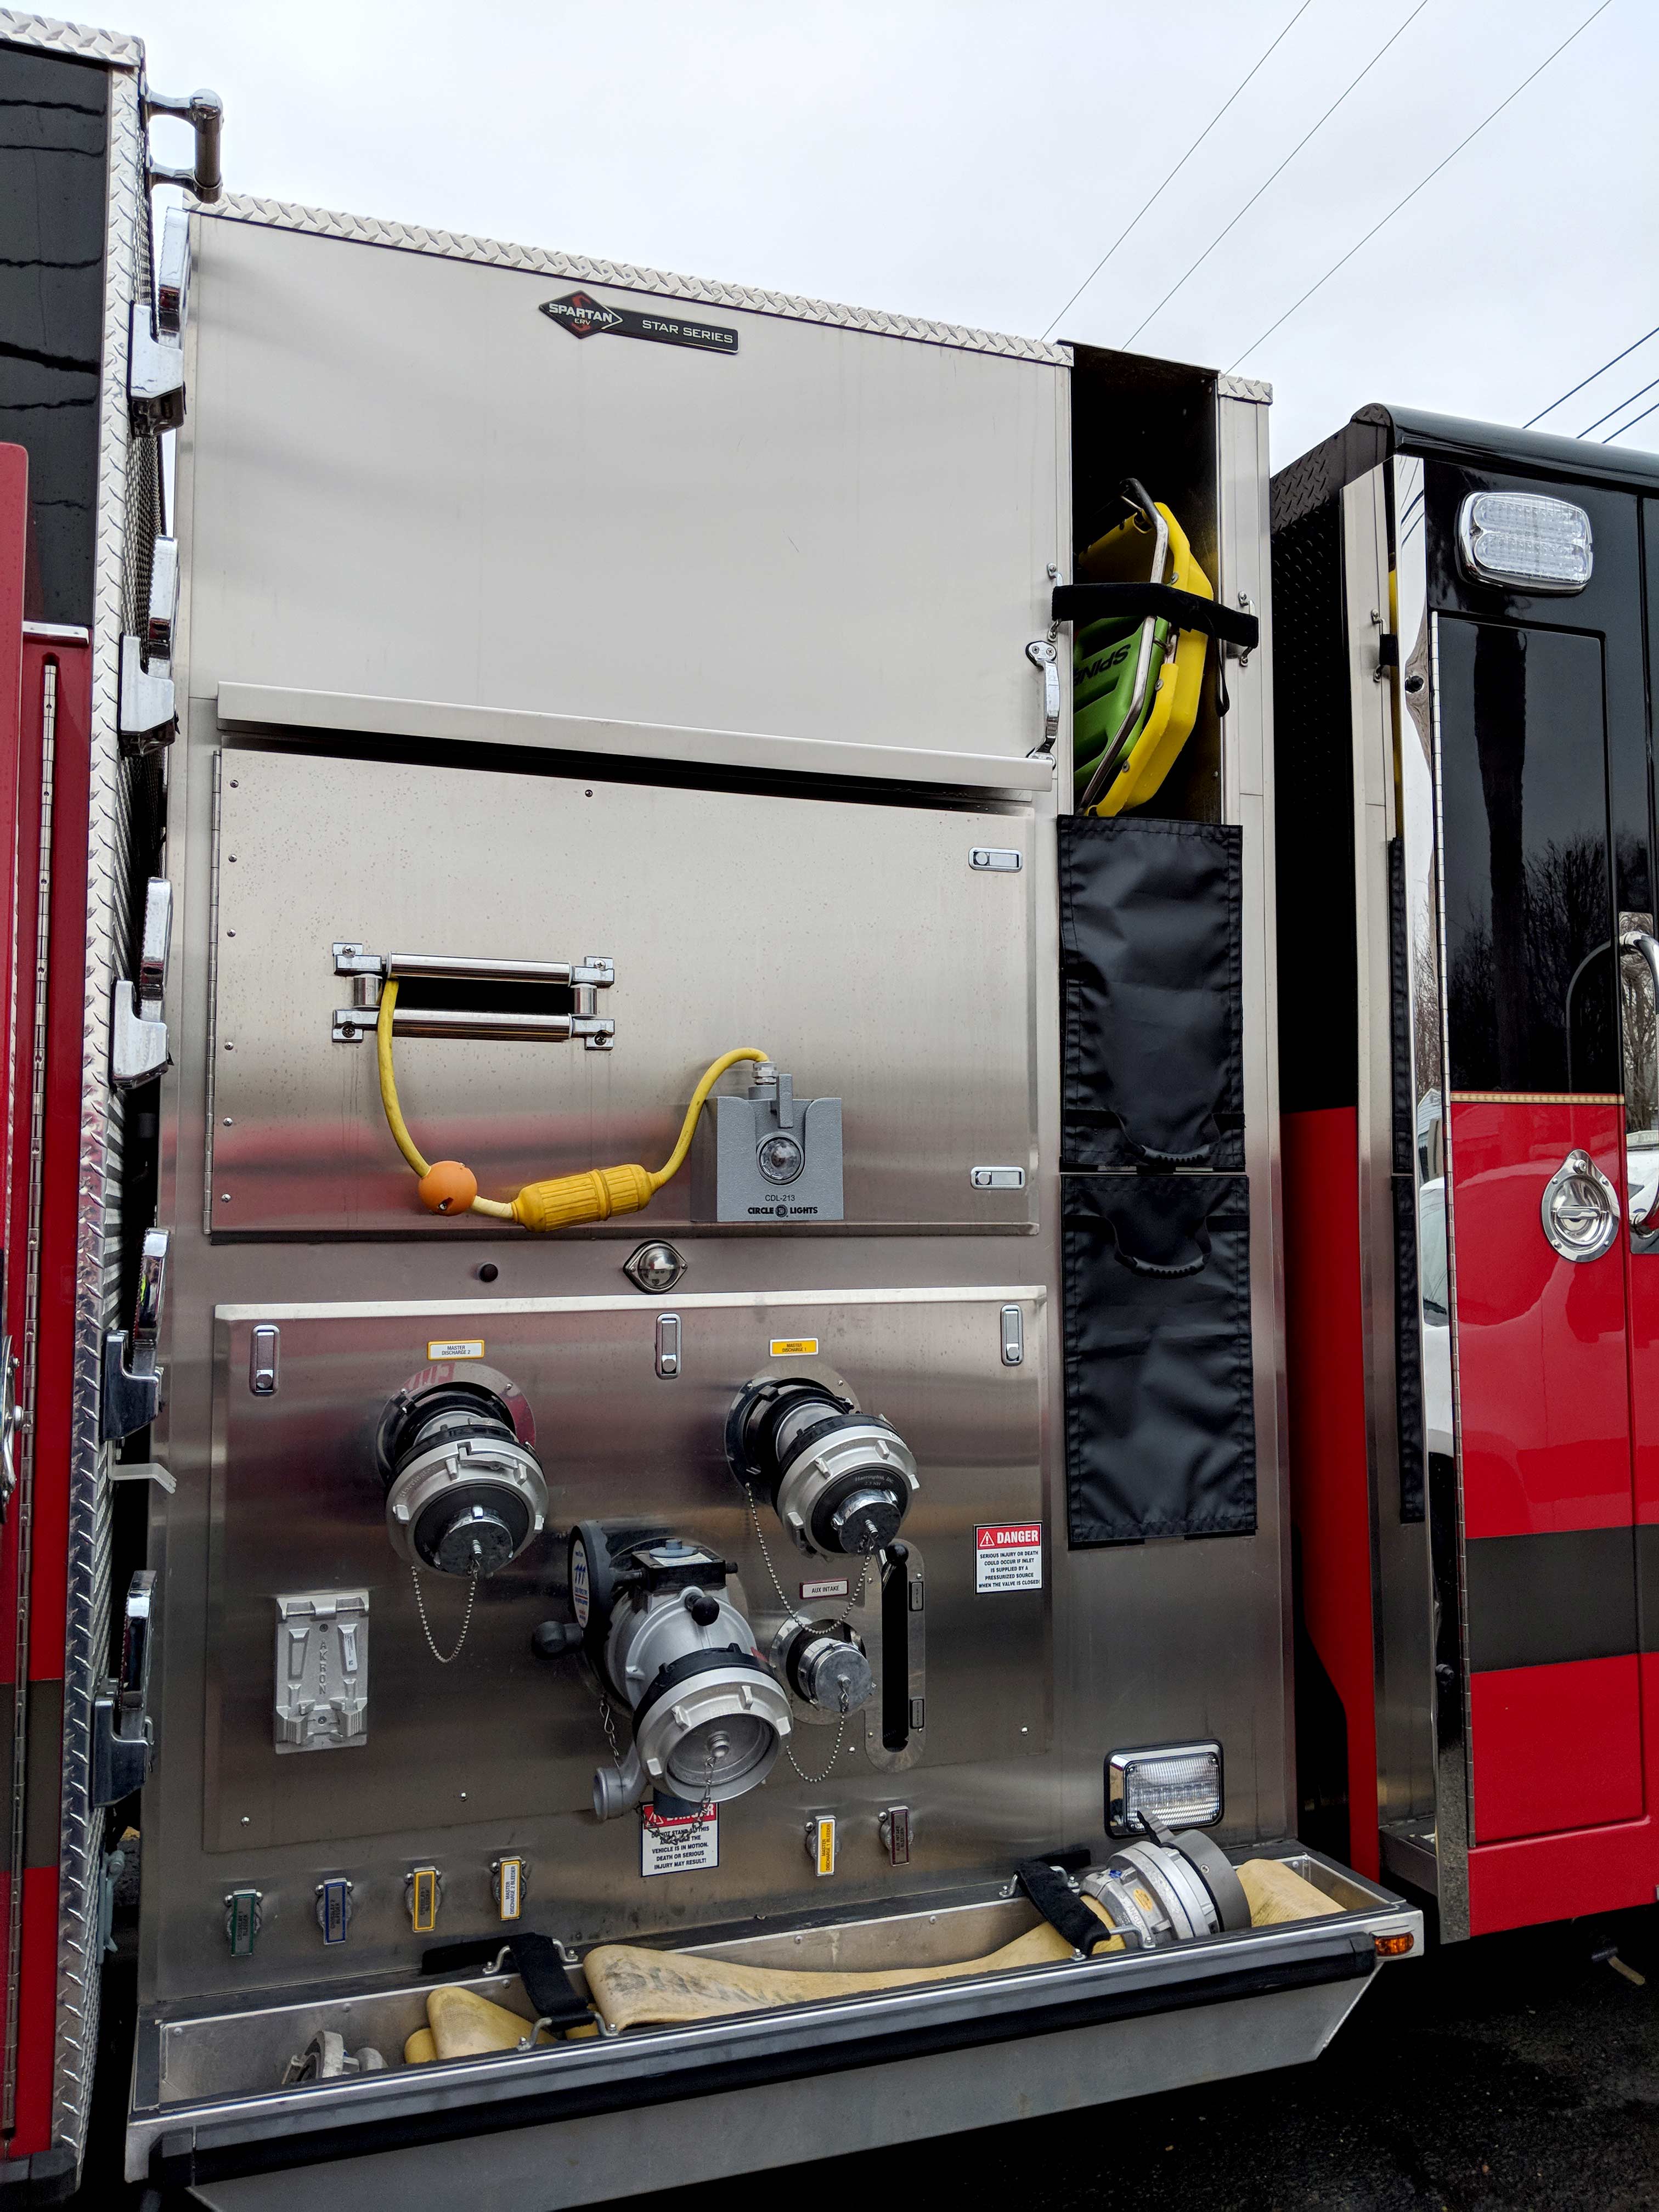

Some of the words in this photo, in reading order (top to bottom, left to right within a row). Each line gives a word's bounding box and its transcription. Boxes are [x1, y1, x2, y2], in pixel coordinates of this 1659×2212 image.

[549, 303, 613, 324] SPARTAN
[642, 319, 679, 334] STAR
[682, 327, 733, 344] SERIES
[997, 1530, 1039, 1544] DANGER
[319, 1640, 328, 1695] AKRON
